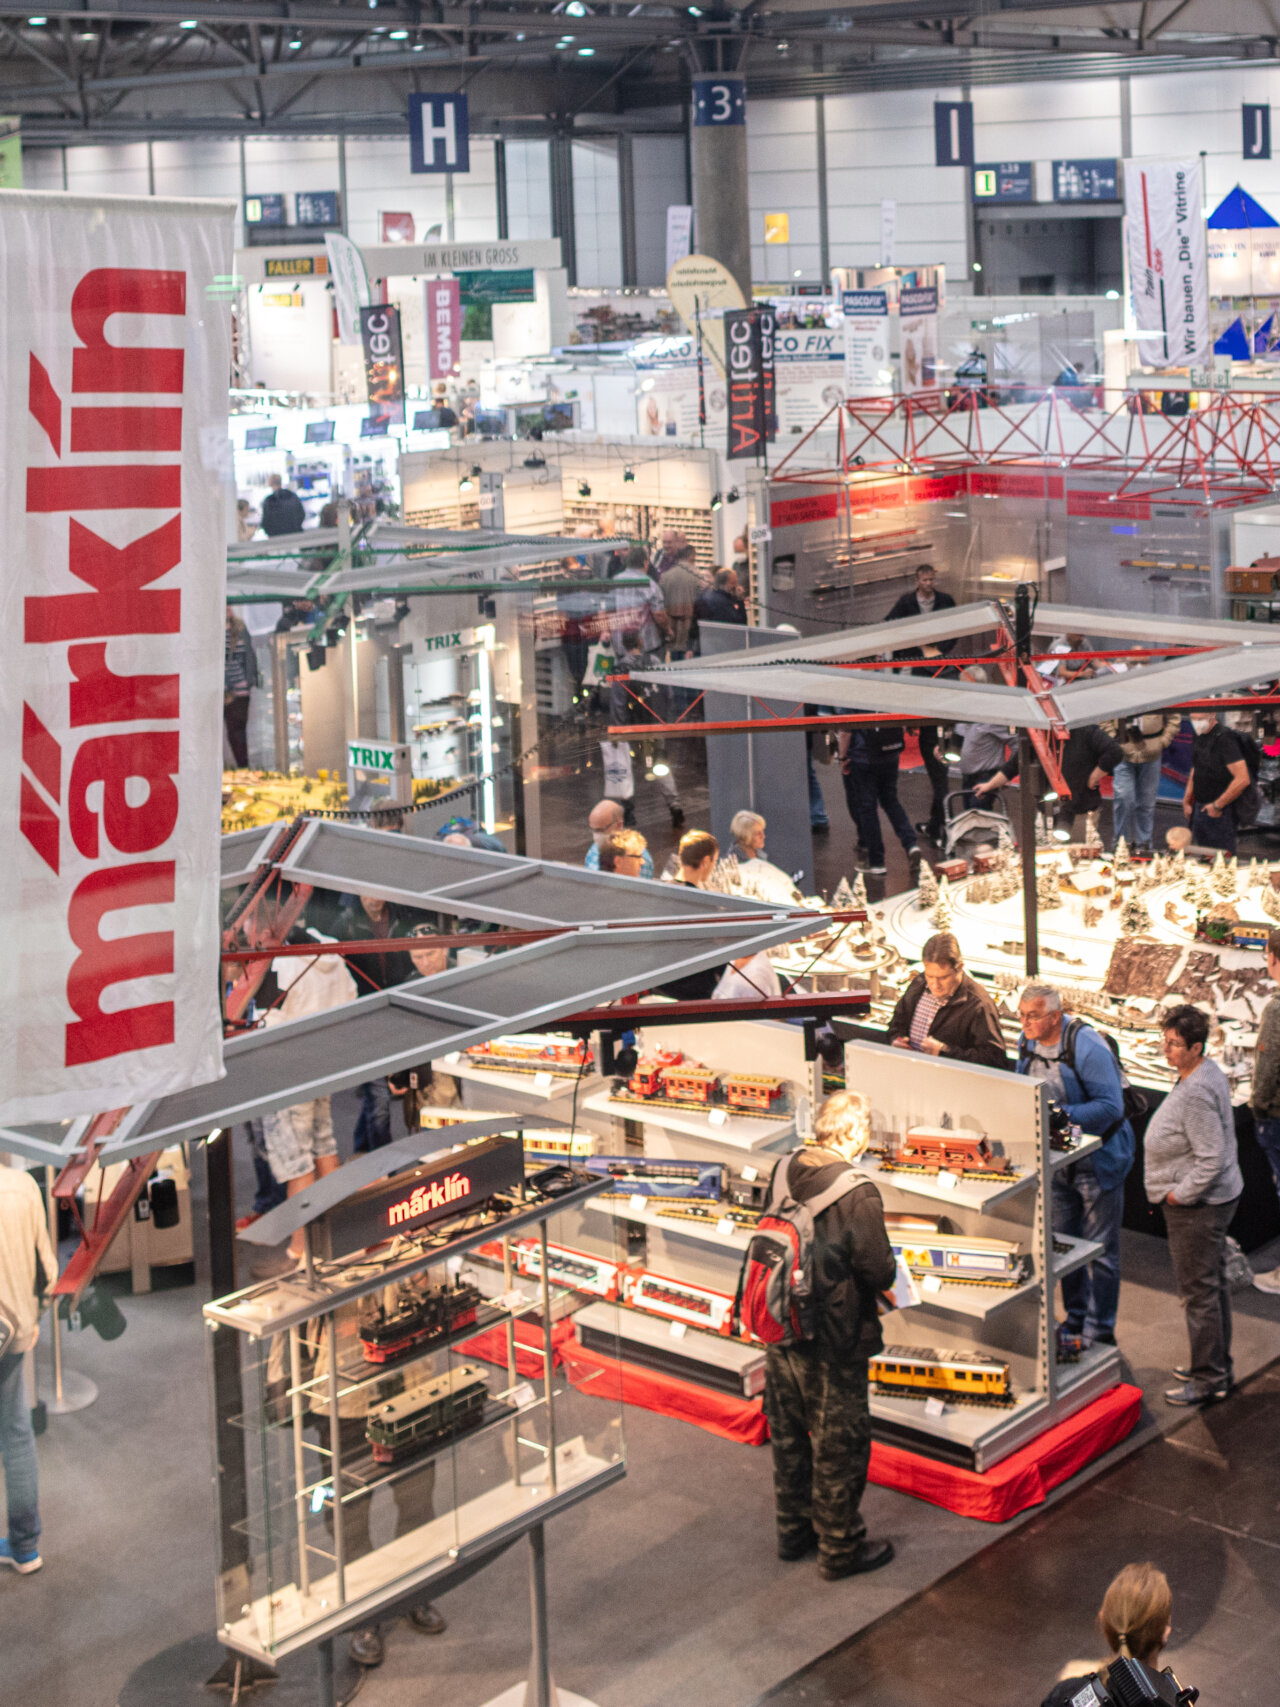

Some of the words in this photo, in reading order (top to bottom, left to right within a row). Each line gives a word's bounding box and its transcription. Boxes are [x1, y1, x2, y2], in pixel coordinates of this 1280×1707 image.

[711, 85, 732, 121] 3
[421, 102, 457, 166] H
[1252, 109, 1263, 154] J
[1176, 171, 1188, 224] Vitrine
[266, 259, 311, 276] FALLER
[424, 252, 437, 269] IM
[441, 250, 482, 268] KLEINEN
[486, 247, 519, 265] GROSS
[1183, 274, 1195, 325] bauen
[436, 289, 452, 372] BEMO
[805, 335, 835, 351] FIX
[1185, 328, 1197, 355] Wir
[425, 632, 462, 651] TRIX
[20, 267, 187, 1069] märklin
[349, 746, 395, 771] TRIX
[388, 1171, 471, 1227] märklin
